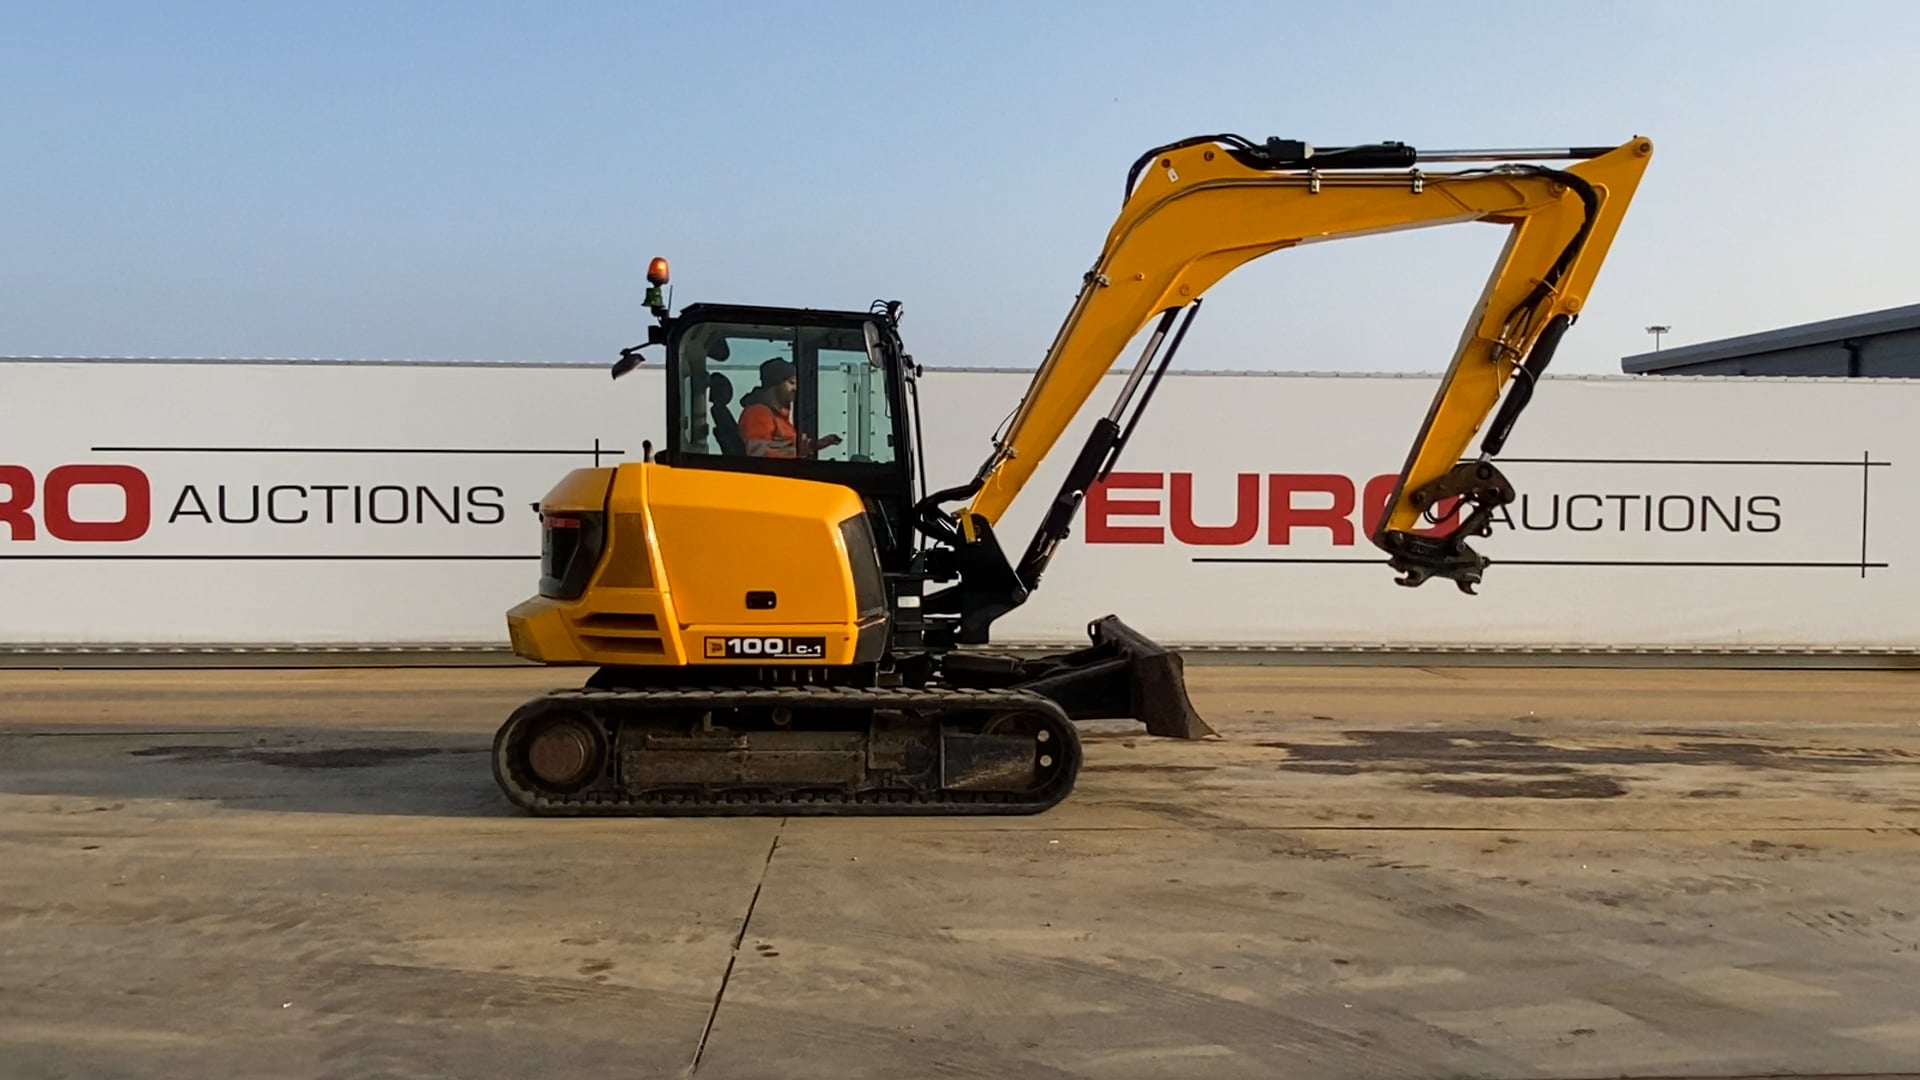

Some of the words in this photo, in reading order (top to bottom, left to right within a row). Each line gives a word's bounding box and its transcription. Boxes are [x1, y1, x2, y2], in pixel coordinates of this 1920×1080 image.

[168, 484, 505, 525] AUCTIONS
[727, 638, 784, 654] 100
[796, 645, 821, 654] C-1
